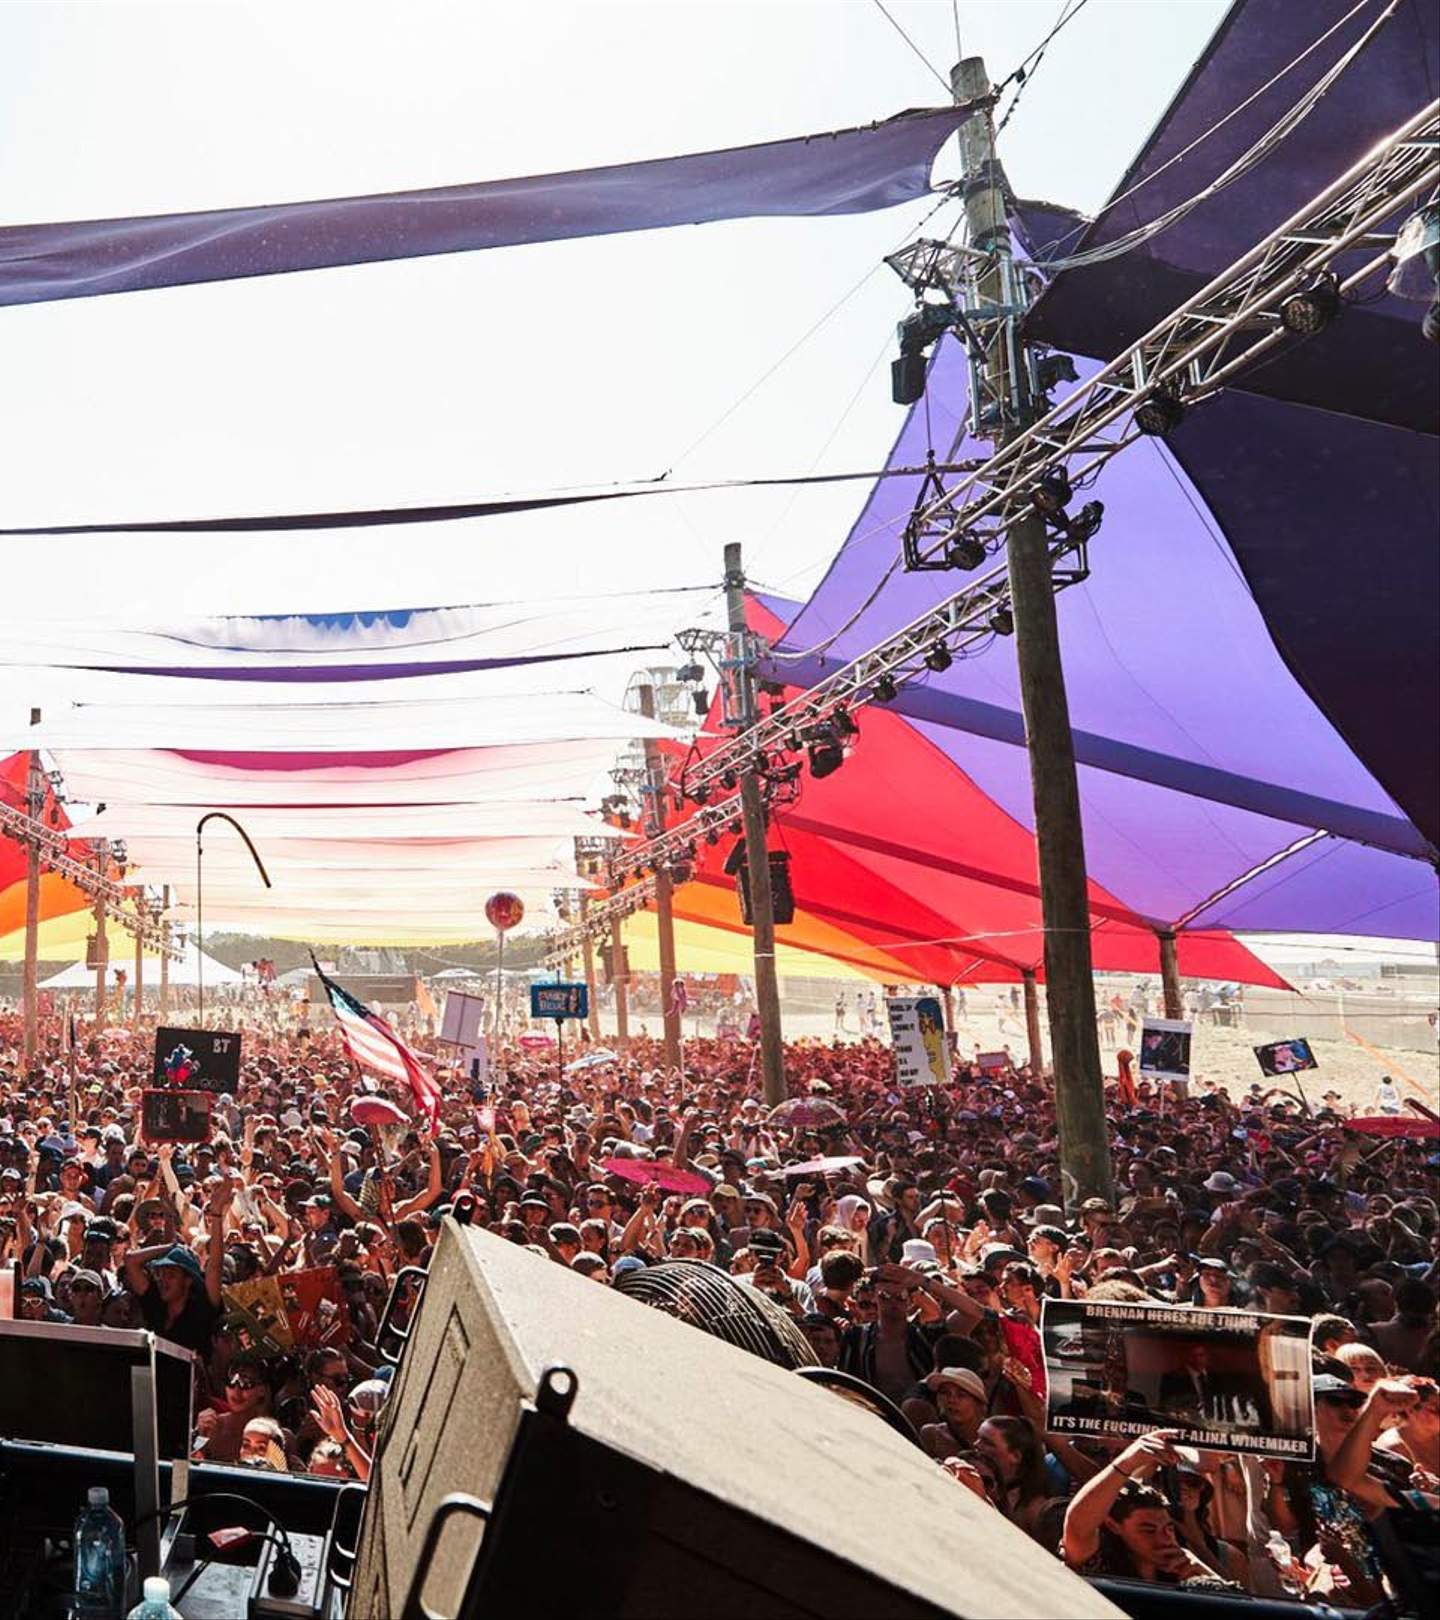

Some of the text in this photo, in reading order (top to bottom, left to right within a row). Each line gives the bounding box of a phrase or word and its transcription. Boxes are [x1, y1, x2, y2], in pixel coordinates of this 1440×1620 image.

[1086, 1305, 1145, 1319] BRENNAN
[1147, 1310, 1187, 1323] HERES
[1190, 1312, 1215, 1326] THE
[1052, 1415, 1076, 1429] IT'S
[1079, 1418, 1101, 1430] THE
[1230, 1434, 1308, 1453] WINEMIXER
